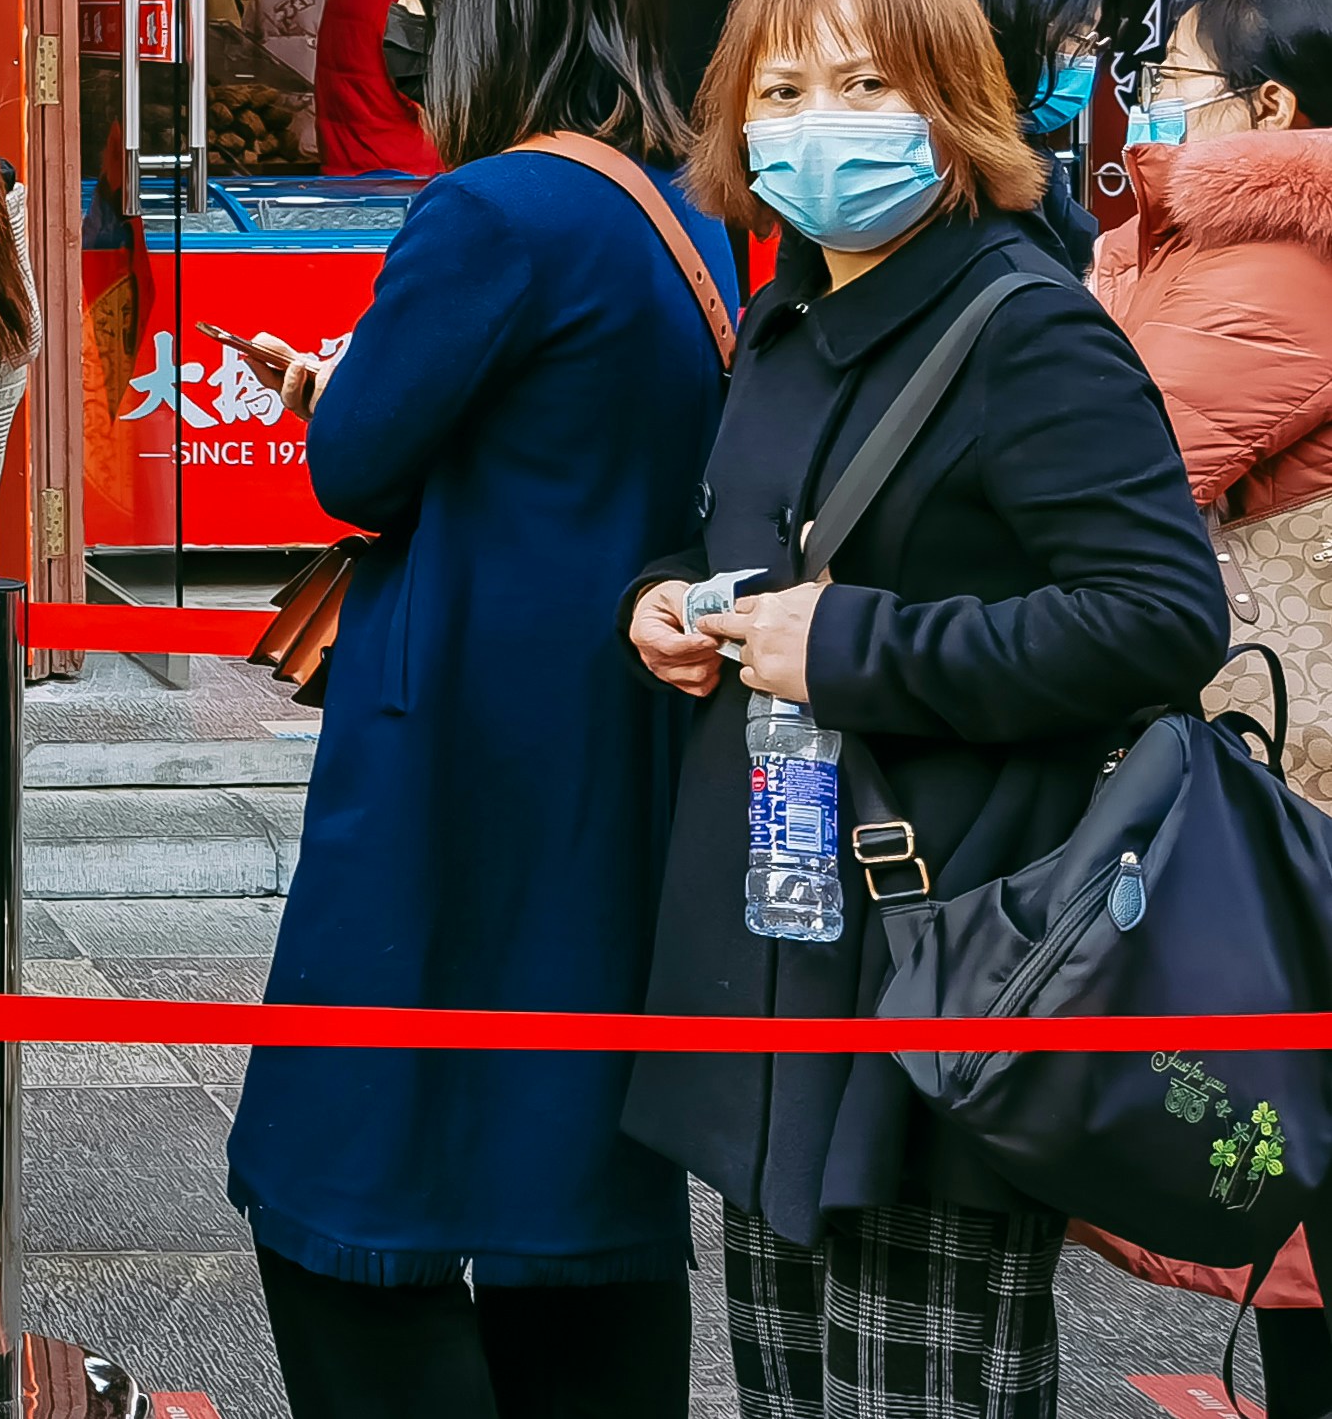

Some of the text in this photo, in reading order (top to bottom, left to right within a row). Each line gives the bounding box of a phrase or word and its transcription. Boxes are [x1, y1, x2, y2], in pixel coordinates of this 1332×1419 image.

[266, 441, 306, 465] 197
[1183, 1060, 1206, 1082] for
[1199, 1076, 1228, 1094] you
